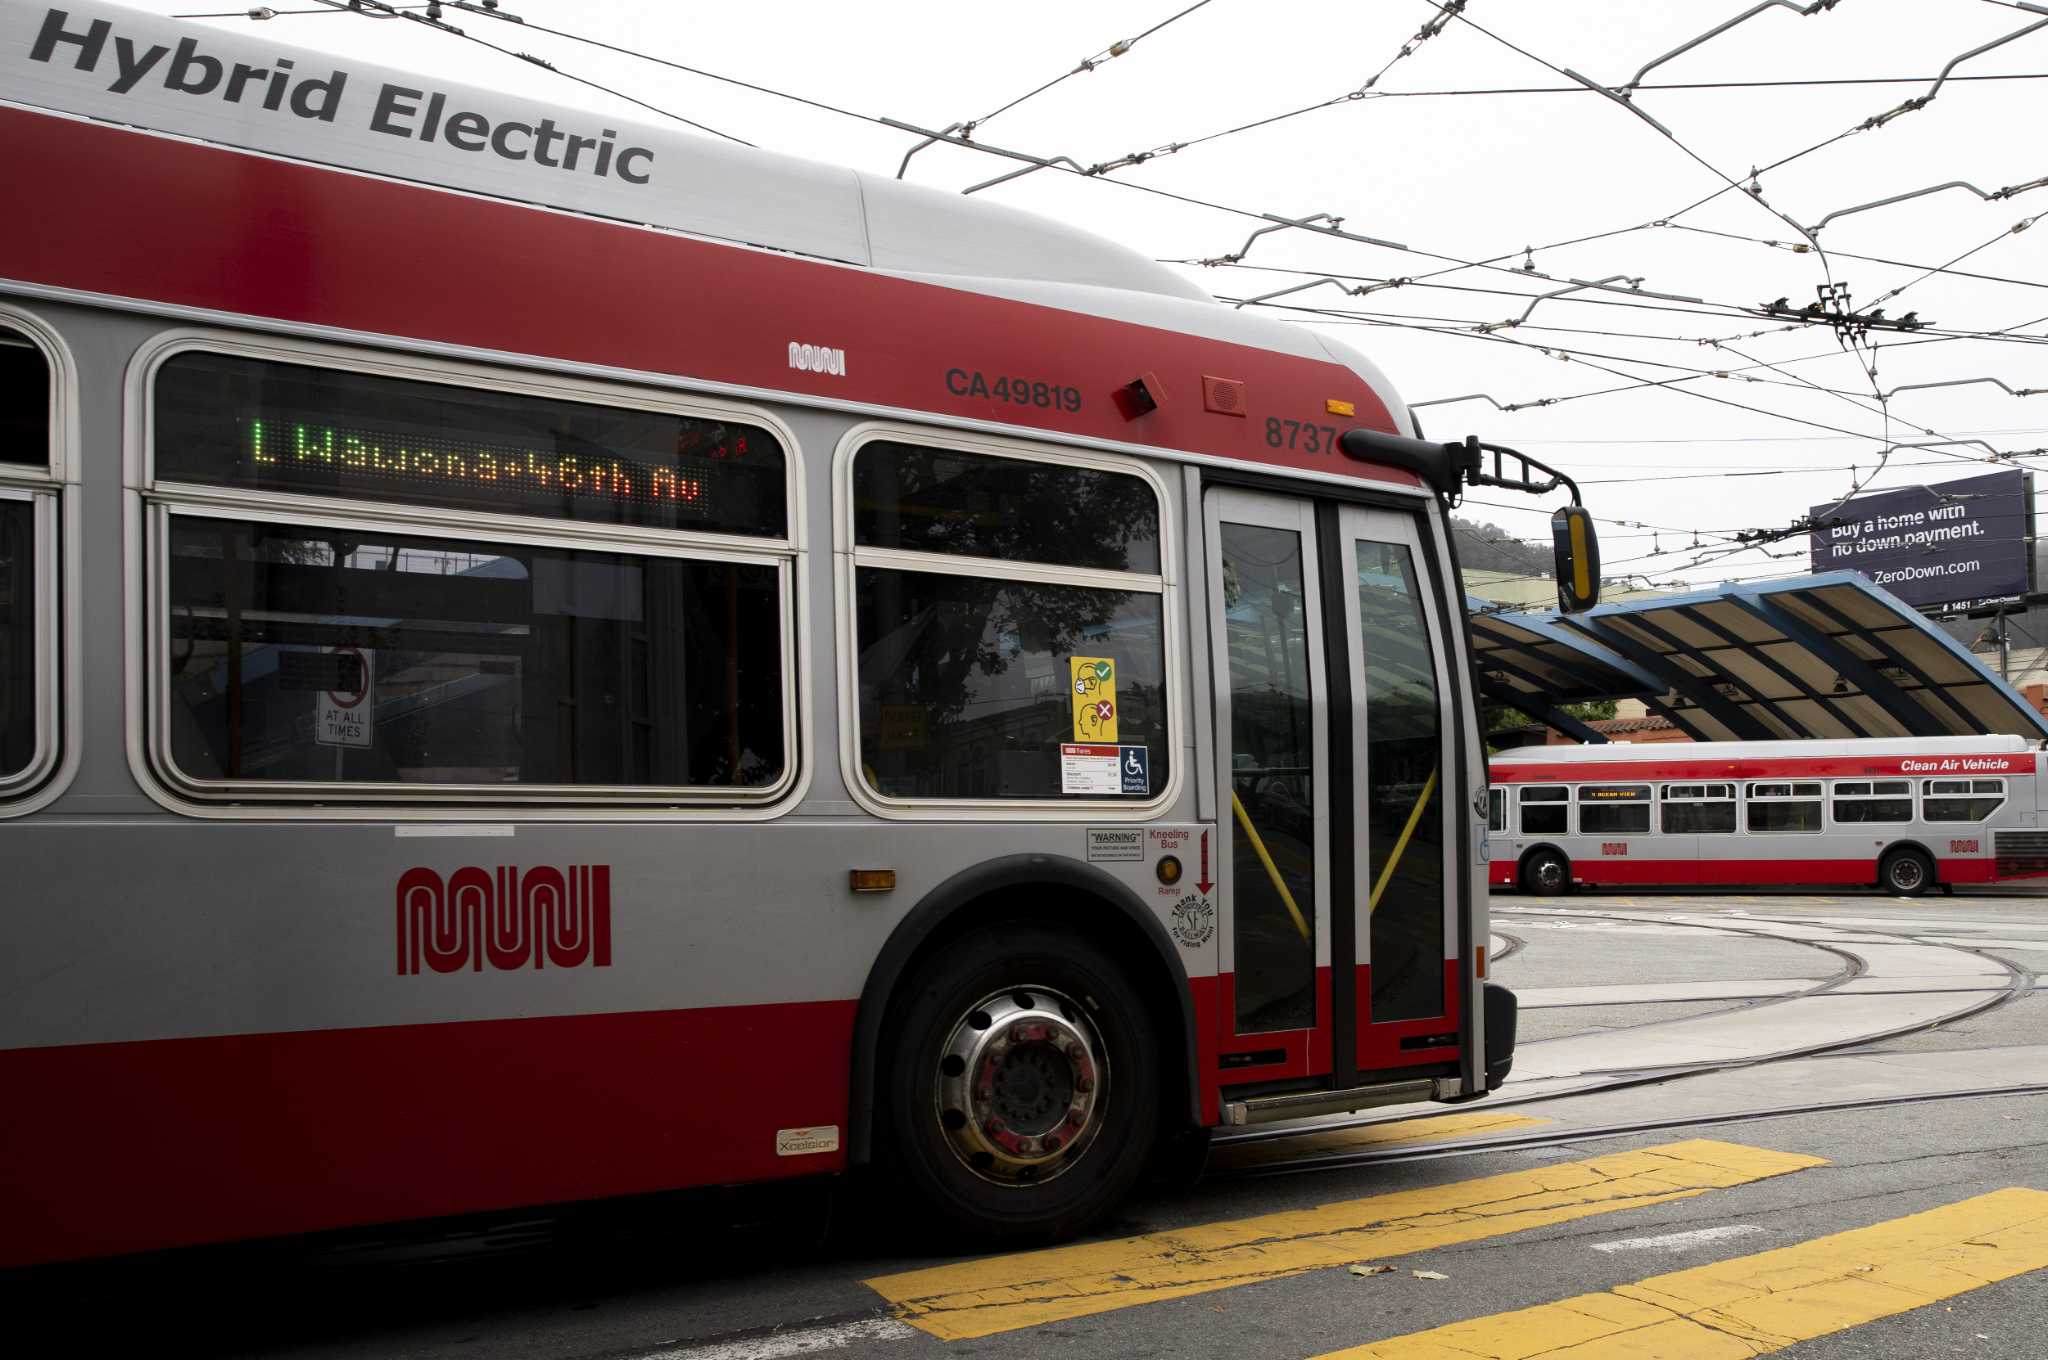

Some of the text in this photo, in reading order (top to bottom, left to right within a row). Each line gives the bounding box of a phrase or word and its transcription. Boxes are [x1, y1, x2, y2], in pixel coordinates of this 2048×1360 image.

[29, 9, 654, 184] Hybrid Electric
[255, 422, 277, 462] L
[1264, 415, 1338, 456] 8737
[1832, 505, 1965, 539] Buy a home with
[1832, 520, 1985, 557] no down payment.
[1874, 559, 1980, 584] ZeroDown.com
[1952, 601, 1971, 611] 1451
[326, 710, 366, 725] AT ALL
[328, 723, 361, 738] TIMES
[1901, 757, 2009, 771] Clean Air Vehicle
[1124, 777, 1145, 785] Priority
[1150, 829, 1189, 841] Kneeling
[1161, 840, 1178, 849] Bus
[1158, 888, 1181, 897] Ramp
[1172, 894, 1214, 917] Thank You
